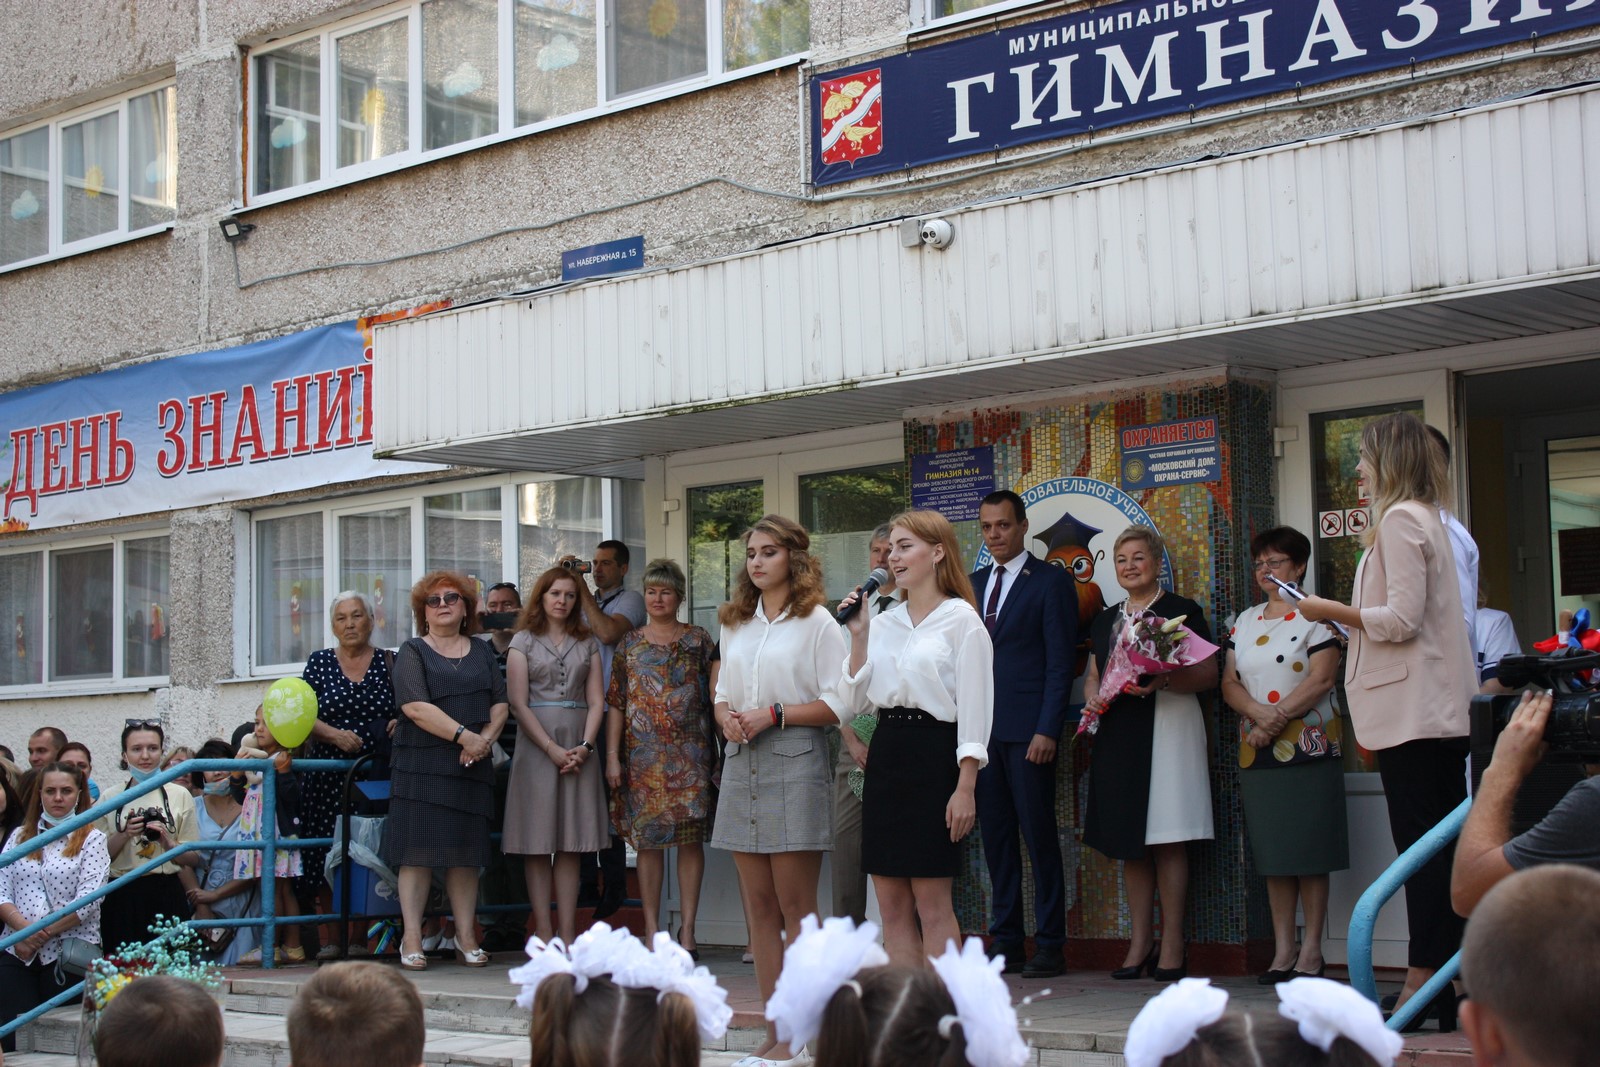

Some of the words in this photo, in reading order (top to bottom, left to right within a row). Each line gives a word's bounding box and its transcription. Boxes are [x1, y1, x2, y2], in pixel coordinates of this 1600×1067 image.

[1008, 0, 1245, 56] МУНИЦИПАЛЬНО
[947, 0, 1600, 143] ГИМНАЗ
[576, 251, 620, 268] НАБЕРЕЖНАЯ
[628, 248, 636, 257] 15
[1122, 418, 1215, 448] ОХРАНЯЕТСЯ
[1187, 446, 1215, 455] ОРГАНИЗАЦИЯ
[3, 410, 136, 520] ДЕНЬ
[925, 469, 962, 480] ГИМНАЗИЯ
[964, 467, 979, 475] №14
[1148, 458, 1196, 472] «МОСКОВСКИЙ
[1197, 457, 1215, 468] ДОМ:
[1154, 468, 1210, 482] ОХРАНА-СЕРВИС»
